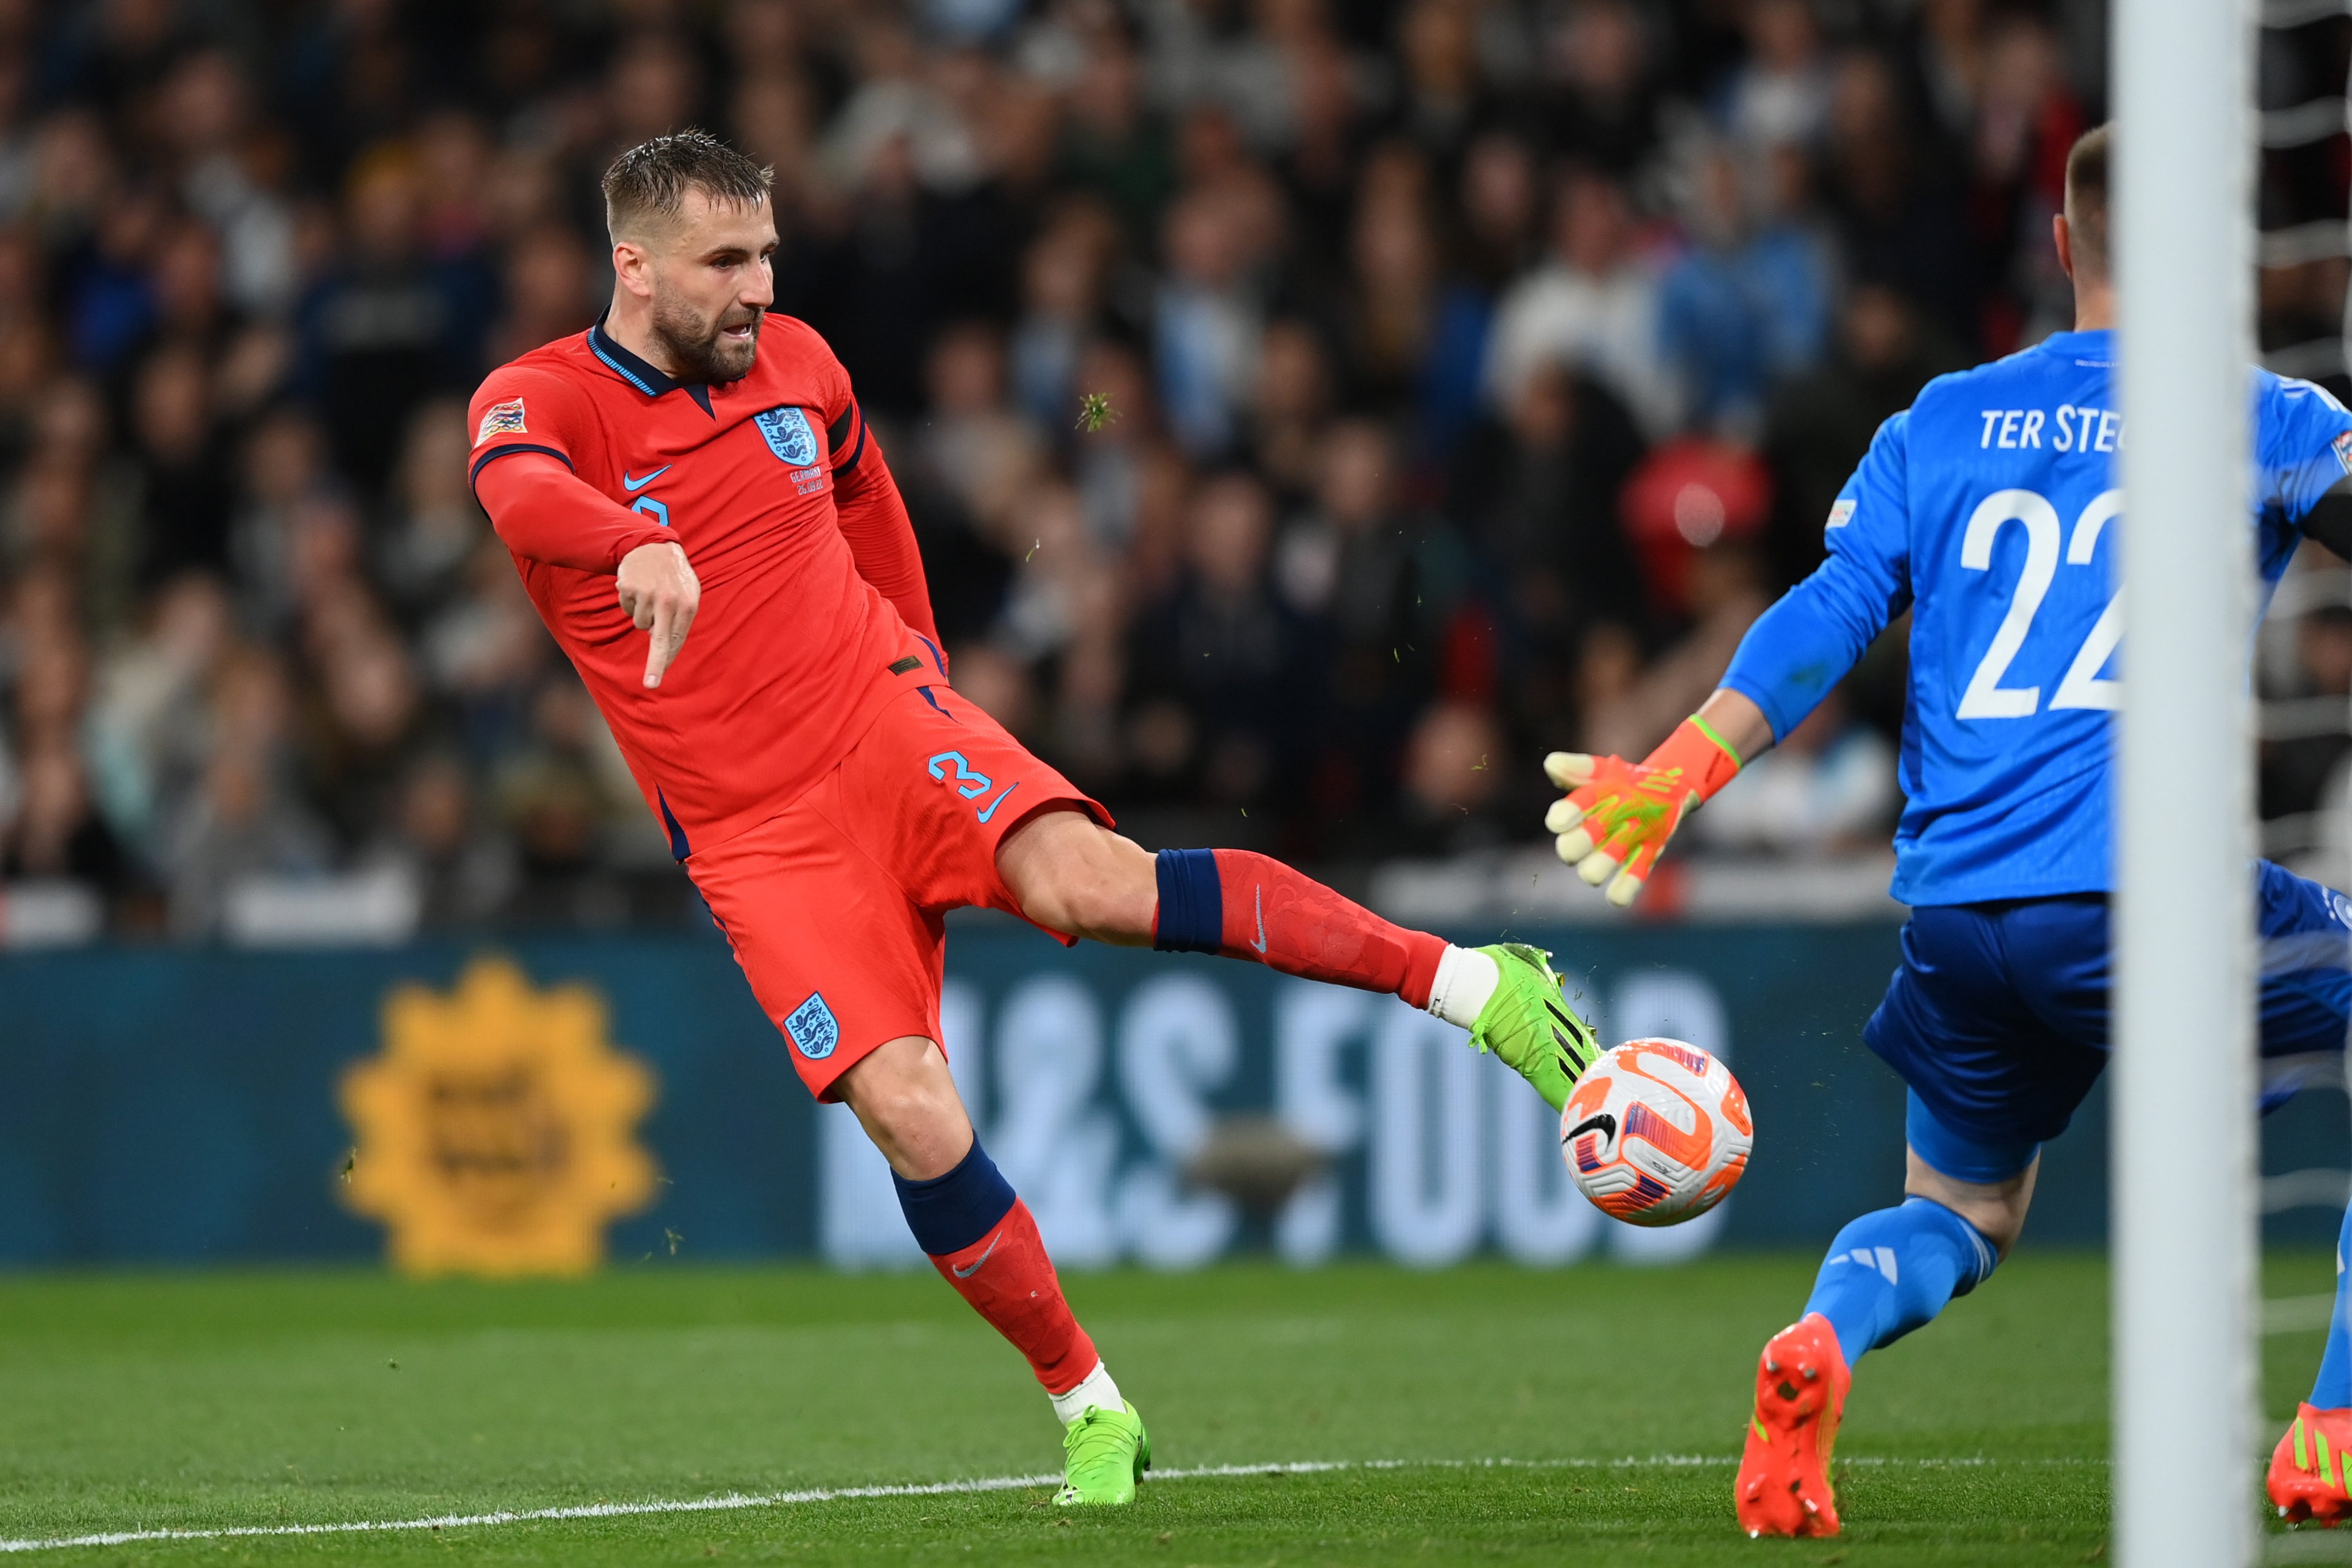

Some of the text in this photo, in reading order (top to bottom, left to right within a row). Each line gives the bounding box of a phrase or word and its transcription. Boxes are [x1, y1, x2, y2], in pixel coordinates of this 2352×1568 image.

[1980, 409, 2046, 450] TER
[790, 466, 821, 483] GERMANY
[928, 750, 992, 800] 3
